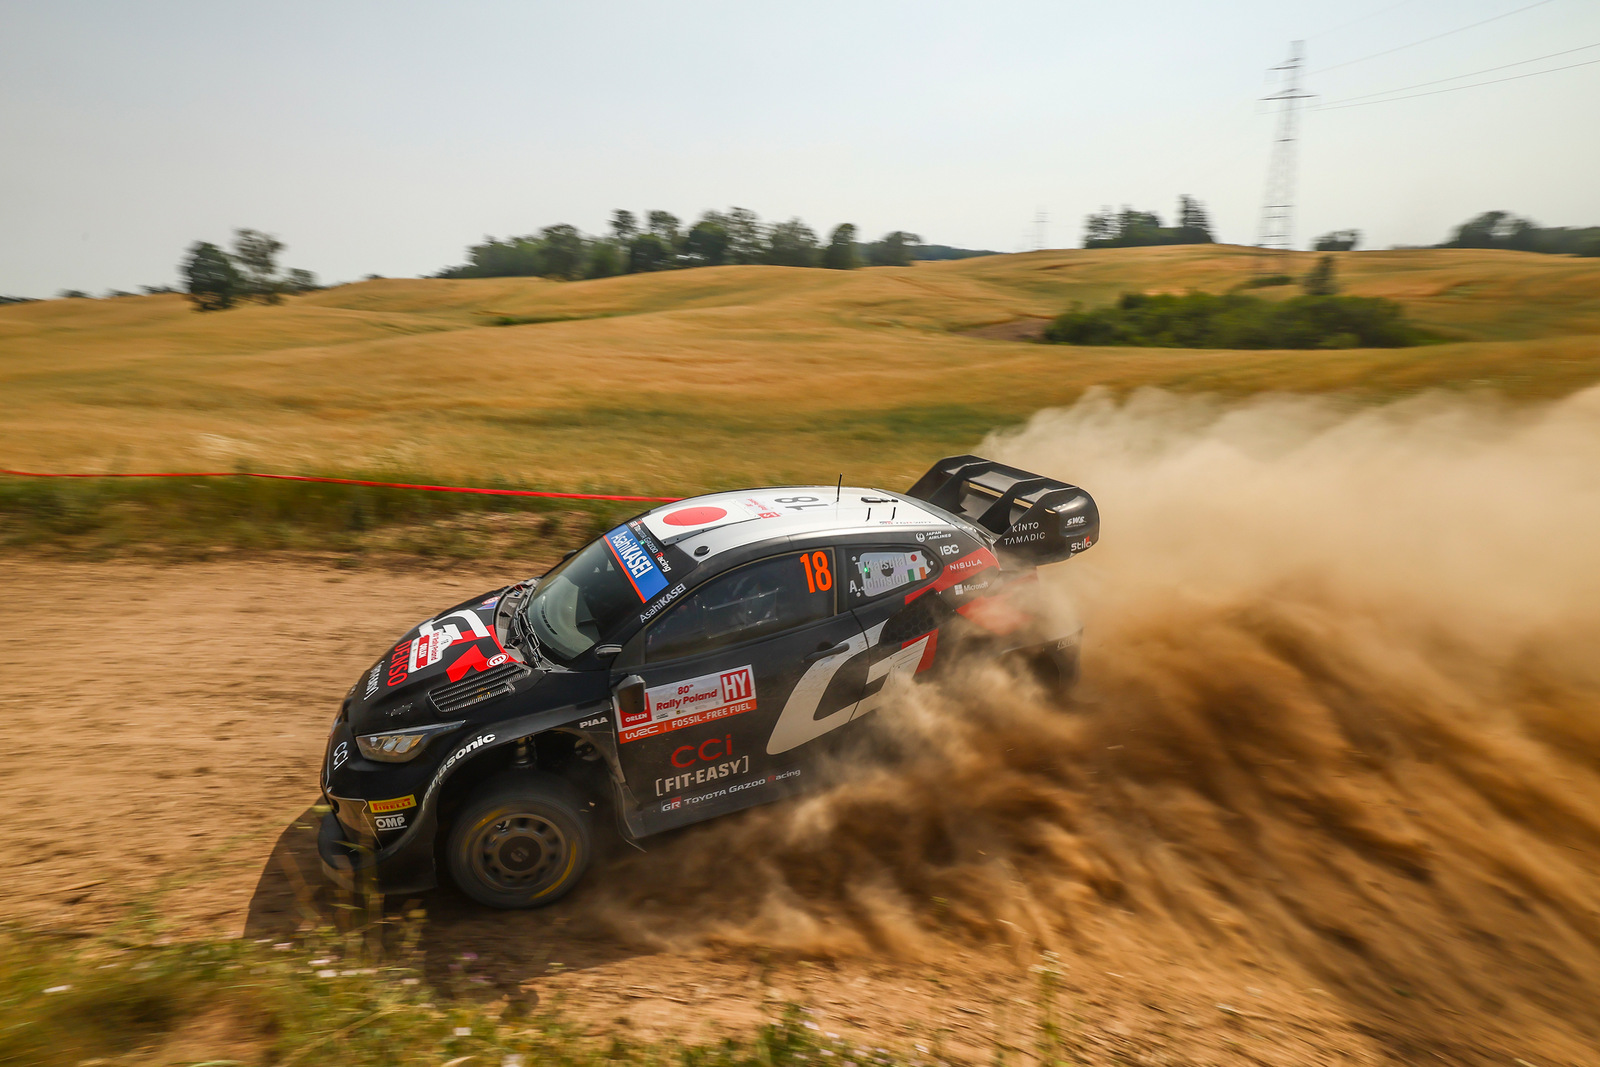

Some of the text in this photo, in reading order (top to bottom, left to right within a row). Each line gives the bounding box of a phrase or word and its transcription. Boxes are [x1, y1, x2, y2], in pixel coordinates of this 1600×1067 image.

[1066, 516, 1086, 527] SWS
[1004, 532, 1045, 546] TAMADIC
[1071, 536, 1093, 552] Stilo
[611, 530, 654, 579] AsahiKASEI
[655, 551, 672, 573] Racing
[800, 551, 832, 593] 18
[950, 559, 982, 571] NISULA
[963, 581, 989, 592] Microsoft
[640, 583, 687, 623] AsahiKASEI
[387, 639, 413, 687] DENSO
[722, 672, 747, 701] HY
[656, 699, 682, 711] Rally
[683, 688, 718, 705] Poland
[579, 716, 609, 729] PIAA
[625, 713, 648, 723] ORLEN
[625, 725, 659, 740] WRC
[671, 705, 729, 729] FOSSIL-FREE
[730, 702, 752, 714] FUEL
[661, 769, 801, 813] GR TOYOTA GAZOO Racing
[373, 798, 411, 811] PIRELLI
[375, 816, 406, 829] OMP
